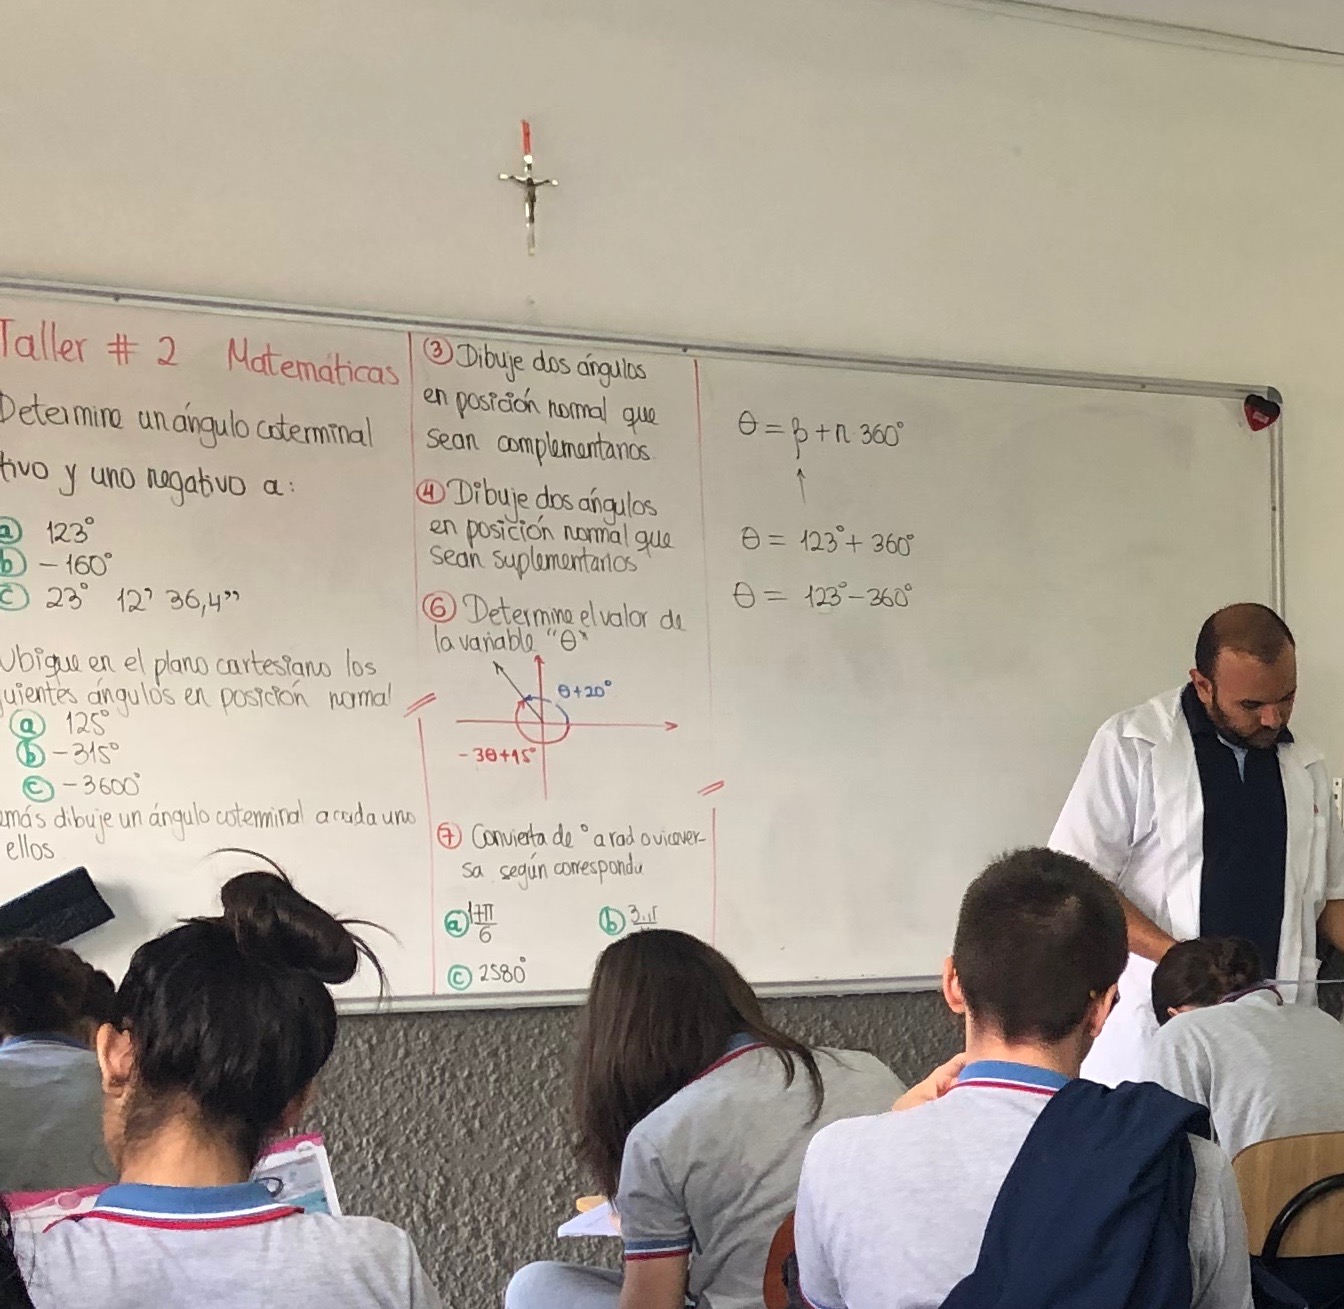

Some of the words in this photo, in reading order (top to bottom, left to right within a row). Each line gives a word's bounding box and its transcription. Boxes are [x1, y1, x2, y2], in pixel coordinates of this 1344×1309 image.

[0, 319, 87, 364] Taller
[107, 333, 139, 366] #
[157, 335, 178, 366] 2
[456, 343, 525, 383] Dibuje
[533, 349, 571, 376] dos
[577, 352, 647, 388] ángulos
[423, 388, 449, 406] en
[456, 388, 542, 420] posición
[549, 396, 607, 424] normal
[623, 407, 659, 435] que
[58, 463, 76, 496] y
[91, 468, 136, 488] uno
[147, 466, 246, 506] negativo
[263, 479, 295, 496] a:
[446, 477, 528, 523] Dibuje
[535, 485, 574, 512] dos
[579, 487, 658, 526] ángulos
[429, 519, 457, 537] en
[467, 515, 555, 549] posición
[564, 526, 628, 549] normal
[635, 531, 676, 560] que
[462, 593, 574, 625] Determine
[580, 600, 597, 629] el
[602, 602, 649, 630] valor
[660, 609, 687, 631] de
[434, 624, 455, 653] la
[458, 628, 536, 654] variable
[88, 653, 115, 675] en
[124, 648, 145, 675] el
[155, 650, 209, 687] plano
[216, 651, 332, 678] cartesiano
[345, 648, 377, 677] los
[88, 678, 176, 718] ángulos
[184, 686, 211, 707] en
[221, 680, 310, 715] posición
[6, 834, 55, 861] ellos
